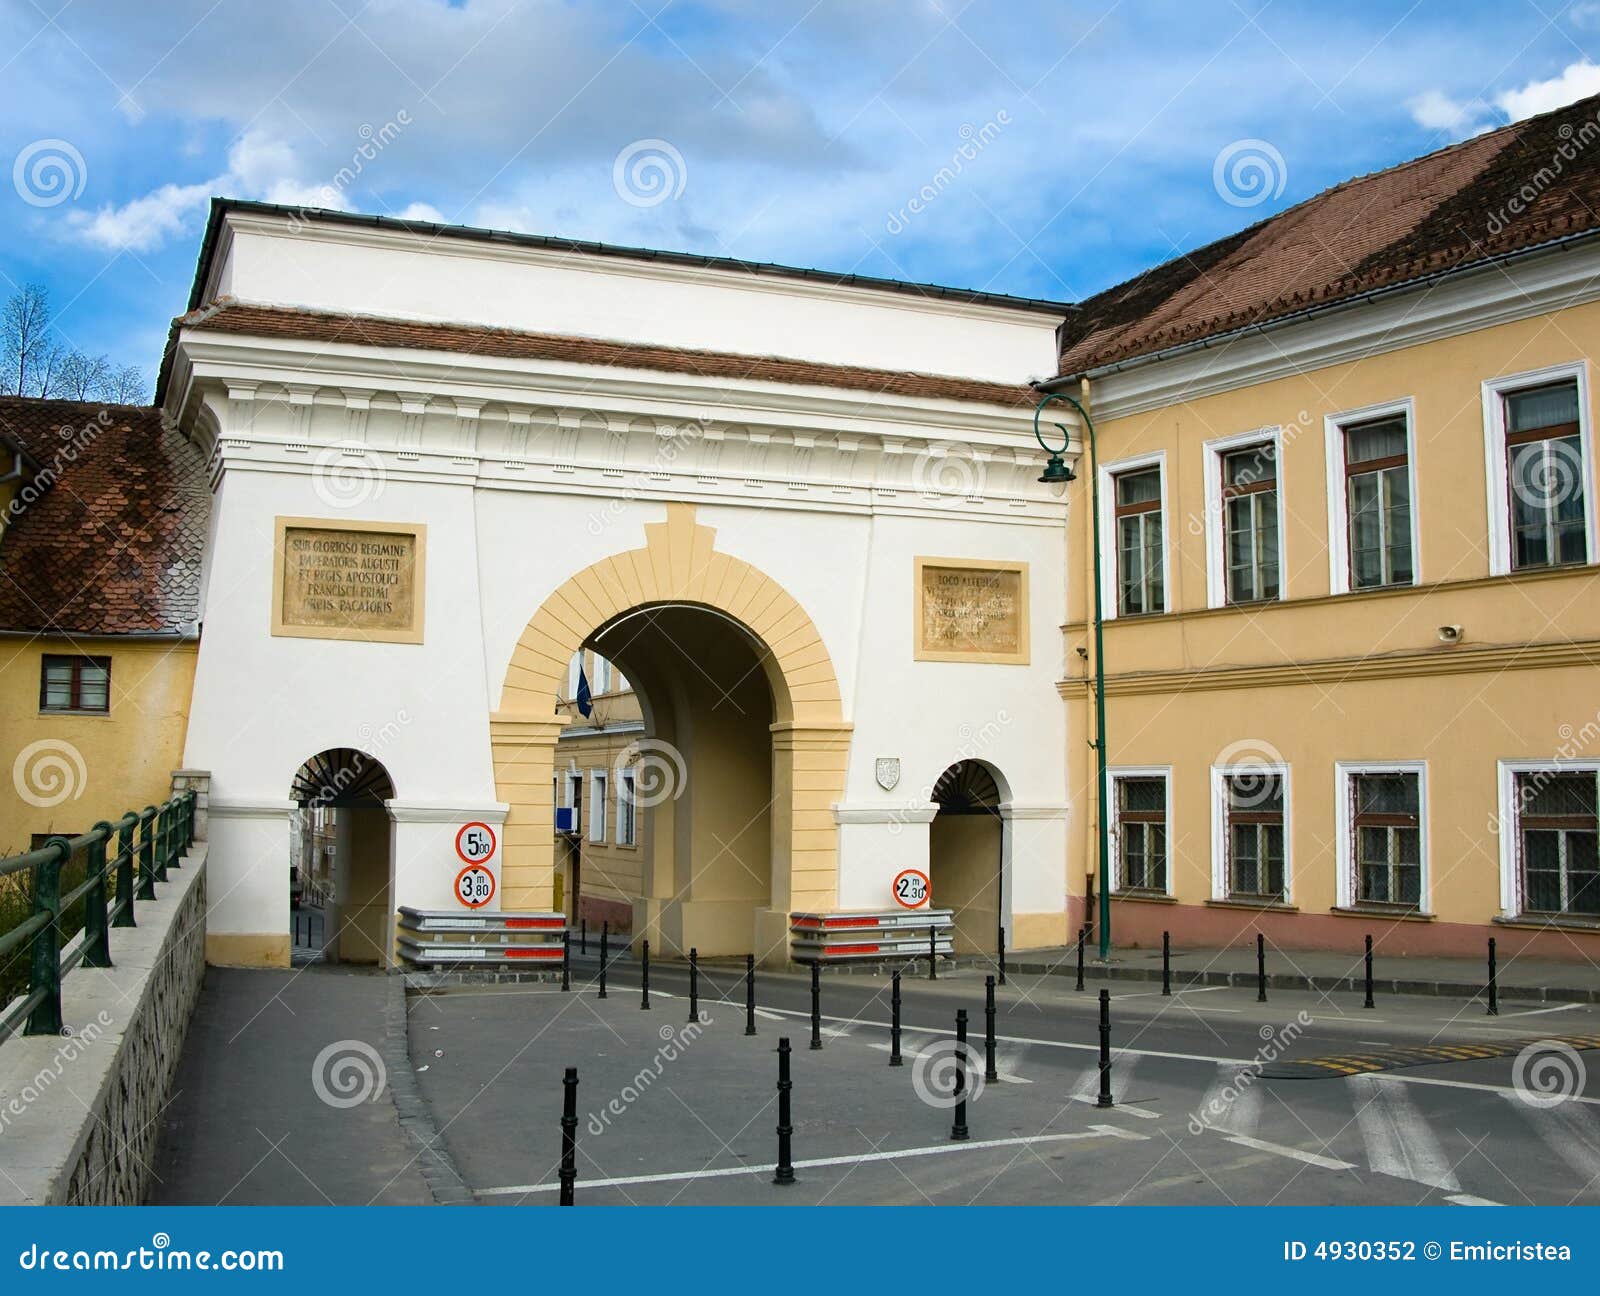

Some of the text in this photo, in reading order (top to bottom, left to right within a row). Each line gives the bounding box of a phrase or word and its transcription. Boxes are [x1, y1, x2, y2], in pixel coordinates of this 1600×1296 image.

[313, 540, 358, 554] GLORIOSO
[361, 543, 406, 557] REGIMINE
[361, 558, 399, 571] AUGUSTI
[314, 570, 342, 582] REGIS
[346, 571, 399, 585] APOSTOLICI
[307, 583, 389, 599] FRANCISCI PRIMI
[340, 599, 393, 613] PACATORIS
